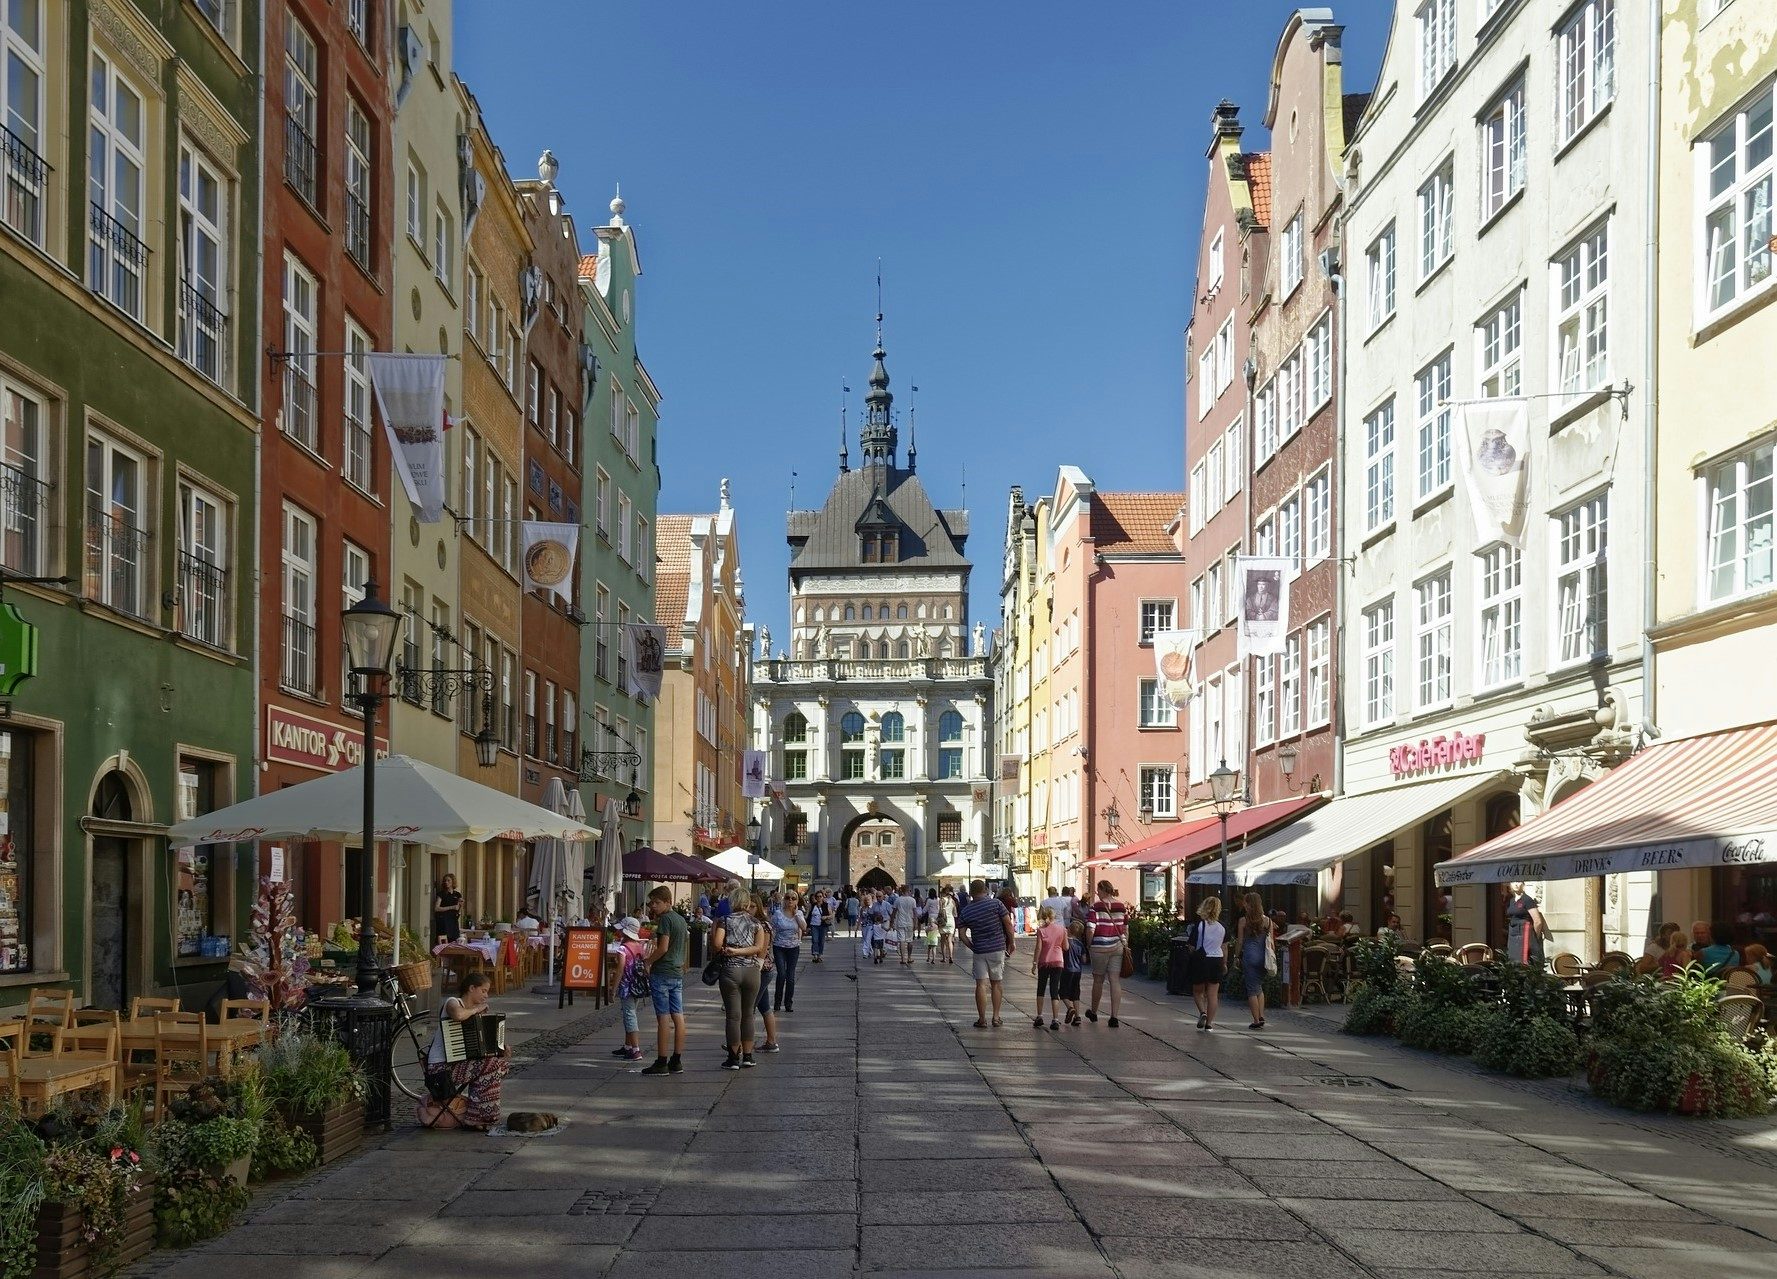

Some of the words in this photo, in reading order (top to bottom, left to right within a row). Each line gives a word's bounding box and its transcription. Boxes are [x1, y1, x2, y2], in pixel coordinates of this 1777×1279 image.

[271, 720, 327, 757] KANTOR
[1575, 856, 1613, 874] DRINKS
[1641, 848, 1683, 866] BEERS
[1497, 863, 1547, 877] COCKTAILS
[572, 964, 594, 979] 0%
